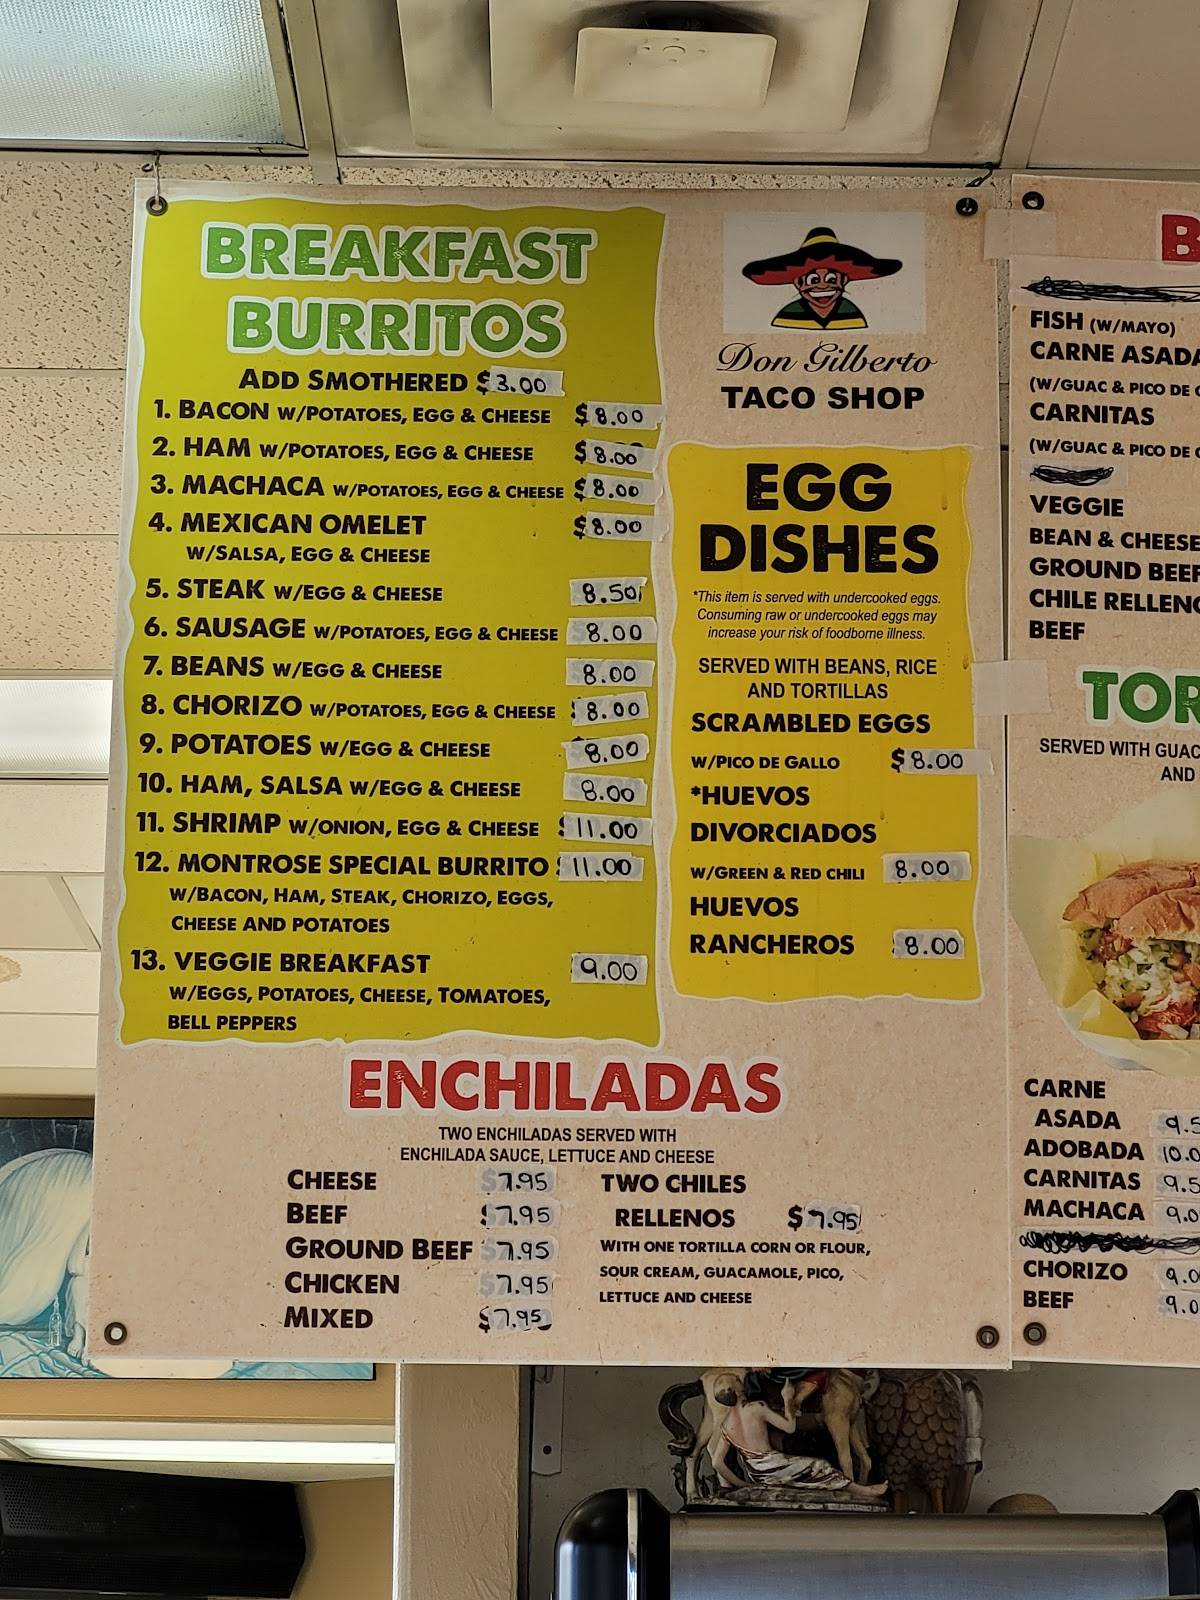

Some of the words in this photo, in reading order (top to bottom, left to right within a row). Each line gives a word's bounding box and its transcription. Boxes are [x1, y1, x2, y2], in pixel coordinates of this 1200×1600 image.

[206, 225, 593, 281] BREAKFAST
[231, 300, 563, 353] BURRITOS
[1031, 311, 1083, 330] FISH
[1090, 318, 1175, 337] (W/MAYO)
[717, 343, 797, 371] Don
[804, 341, 937, 372] Gilberto
[239, 369, 299, 389] ADD
[308, 370, 468, 391] SMOTHERED
[721, 387, 815, 409] TACO
[828, 387, 924, 409] SHOP
[154, 400, 170, 418] 1.
[180, 400, 269, 419] BACON
[414, 408, 454, 422] EGG
[461, 408, 475, 423] &
[482, 408, 550, 423] CHEESE
[1030, 403, 1154, 425] CARNITAS
[151, 474, 173, 494] 3.
[182, 475, 324, 496] MACHACA
[448, 485, 483, 497] EGG
[488, 486, 500, 498] &
[506, 486, 563, 498] CHEESE
[747, 463, 891, 512] EGG
[1030, 495, 1123, 517] VEGGIE
[149, 512, 172, 532] 4.
[181, 513, 312, 533] MEXICAN
[320, 514, 426, 534] OMELET
[1030, 528, 1091, 546] BEAN
[1098, 531, 1114, 547] &
[701, 524, 938, 574] DISHES
[146, 578, 168, 598] 5.
[177, 578, 264, 599] STEAK
[352, 586, 366, 600] &
[373, 586, 442, 601] CHEESE
[725, 592, 749, 602] item
[753, 591, 762, 602] is
[765, 592, 804, 602] served
[808, 592, 829, 602] with
[834, 592, 907, 603] undercooked
[911, 595, 941, 606] eggs.
[698, 608, 762, 623] Consuming
[766, 612, 786, 620] raw
[790, 612, 802, 620] or
[805, 609, 878, 621] undercooked
[882, 613, 909, 624] eggs
[913, 613, 937, 624] may
[708, 629, 756, 638] increase
[760, 630, 786, 641] your
[788, 627, 808, 638] risk
[812, 627, 824, 638] of
[826, 627, 883, 639] foodborne
[887, 628, 925, 639] illness.
[1030, 620, 1085, 640] BEEF
[699, 658, 769, 673] SERVED
[775, 659, 818, 673] WITH
[826, 659, 889, 677] BEANS,
[897, 659, 937, 674] RICE
[748, 683, 785, 698] AND
[791, 683, 888, 698] TORTILLAS
[692, 713, 850, 732] SCRAMBLED
[859, 714, 930, 733] EGGS
[760, 757, 779, 768] DE
[785, 756, 840, 769] GALLO
[138, 773, 172, 793] 10.
[182, 775, 252, 797] HAM,
[261, 776, 342, 795] SALSA
[429, 781, 443, 796] &
[450, 781, 520, 796] CHEESE
[136, 812, 164, 832] 11.
[173, 812, 281, 833] SHRIMP
[398, 820, 440, 835] EGG
[447, 821, 462, 835] &
[469, 820, 538, 836] CHEESE
[691, 823, 876, 843] DIVORCIADOS
[135, 852, 169, 872] 12.
[178, 854, 321, 873] MONTROSE
[329, 855, 430, 875] SPECIAL
[438, 857, 549, 876] BURRITO
[773, 867, 785, 879] &
[791, 867, 821, 879] RED
[827, 869, 864, 880] CHILI
[275, 888, 325, 905] HAM,
[331, 889, 396, 906] STEAK,
[403, 890, 492, 907] CHORIZO,
[498, 891, 553, 907] EGGS,
[691, 897, 798, 917] HUEVOS
[172, 916, 236, 930] CHEESE
[243, 917, 286, 931] AND
[293, 918, 389, 933] POTATOES
[691, 935, 854, 955] RANCHEROS
[131, 950, 165, 970] 13.
[175, 952, 271, 971] VEGGIE
[281, 953, 430, 973] BREAKFAST
[259, 986, 354, 1004] POTATOES,
[360, 988, 432, 1005] CHEESE,
[438, 987, 550, 1007] TOMATOES,
[168, 1015, 210, 1029] BELL
[217, 1016, 296, 1030] PEPPERS
[348, 1059, 782, 1112] ENCHILADAS
[1024, 1079, 1105, 1098] CARNE
[1035, 1109, 1121, 1129] ASADA
[439, 1127, 472, 1140] TWO
[477, 1127, 571, 1141] ENCHILADAS
[576, 1128, 635, 1141] SERVED
[640, 1129, 676, 1142] WITH
[401, 1148, 486, 1161] ENCHILADA
[490, 1148, 543, 1164] SAUCE,
[549, 1149, 615, 1162] LETTUCE
[619, 1150, 650, 1163] AND
[655, 1150, 714, 1163] CHEESE
[1024, 1139, 1144, 1160] ADOBADA
[288, 1169, 376, 1190] CHEESE
[601, 1174, 659, 1192] TWO
[666, 1175, 746, 1193] CHILES
[1024, 1169, 1140, 1190] CARNITAS
[287, 1203, 347, 1224] BEEF
[616, 1209, 735, 1227] RELLENOS
[1024, 1199, 1145, 1220] MACHACA
[286, 1237, 403, 1259] GROUND
[413, 1239, 472, 1260] BEEF
[600, 1240, 639, 1252] WITH
[643, 1241, 674, 1252] ONE
[679, 1242, 746, 1252] TORTILLA
[751, 1242, 790, 1253] CORN
[795, 1243, 815, 1253] OR
[820, 1243, 870, 1256] FLOUR,
[600, 1266, 639, 1278] SOUR
[644, 1267, 699, 1280] CREAM,
[704, 1267, 802, 1280] GUACAMOLE,
[807, 1268, 843, 1281] PICO,
[1024, 1260, 1127, 1280] CHORIZO
[285, 1271, 399, 1293] CHICKEN
[1024, 1290, 1073, 1308] BEEF
[284, 1306, 373, 1328] MIXED
